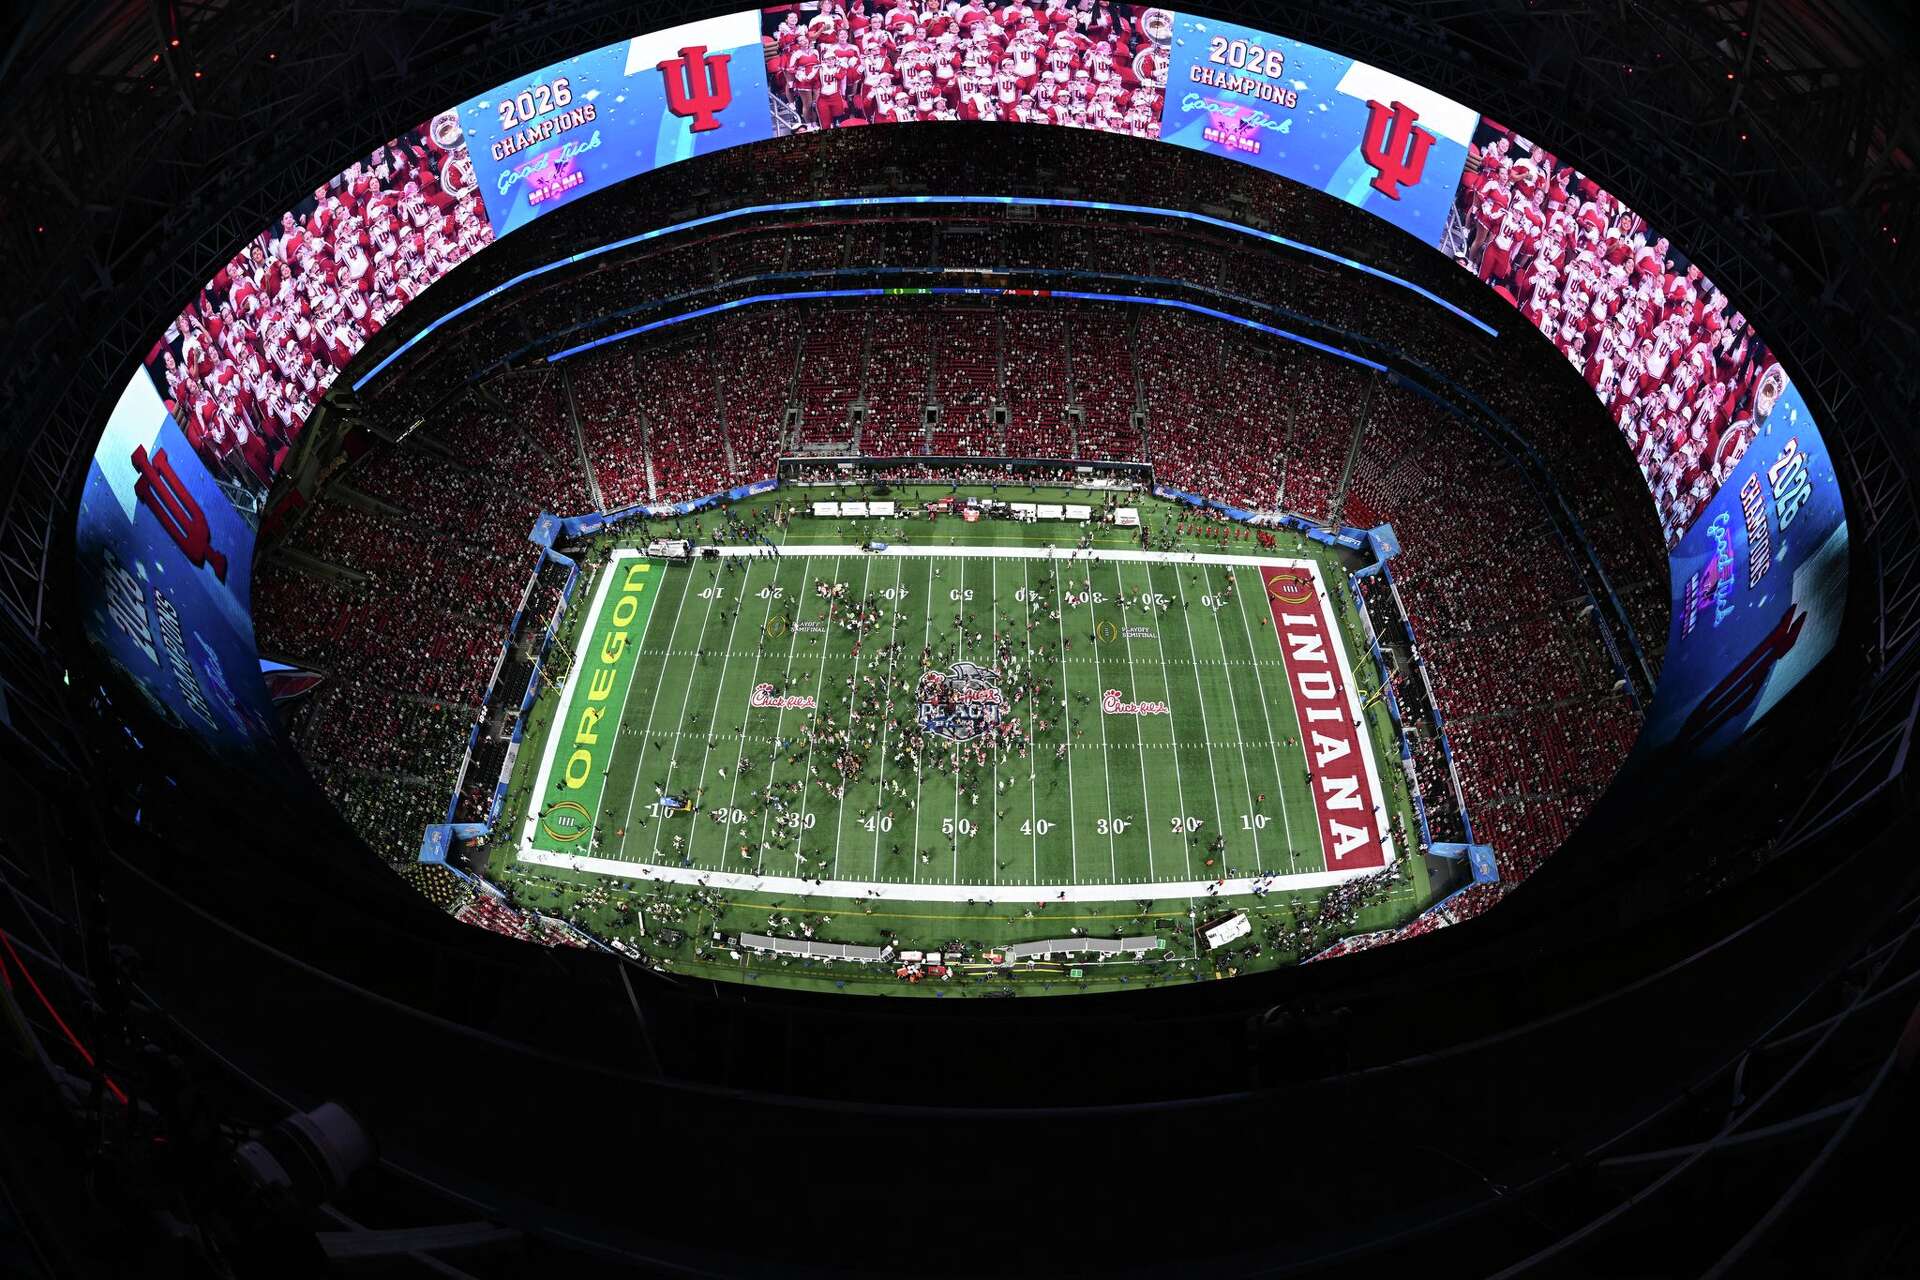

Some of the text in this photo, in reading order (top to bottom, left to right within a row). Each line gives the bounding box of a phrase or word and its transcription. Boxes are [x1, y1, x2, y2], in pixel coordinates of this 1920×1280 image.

[1209, 35, 1285, 79] 2026
[1190, 64, 1298, 109] CHAMPIONS
[499, 76, 573, 131] 2026
[1180, 92, 1293, 134] Good Luck
[491, 104, 597, 161] CHAMPIONS
[1203, 127, 1261, 154] MIAMI
[497, 130, 601, 195] Good Luck
[528, 171, 585, 206] MIAMI
[1767, 437, 1813, 532] 2026
[1338, 534, 1362, 546] ESPN
[1740, 472, 1770, 590] CHAMPIONS
[702, 587, 724, 599] 10
[885, 588, 909, 600] 40
[950, 589, 974, 601] 50
[1015, 590, 1038, 602] 40
[1201, 595, 1224, 607] 10
[565, 564, 650, 789] OREGON
[1103, 688, 1169, 715] Chick-fil-A
[1281, 613, 1370, 859] INDIANA
[718, 808, 742, 824] 20
[864, 817, 892, 832] 40
[942, 818, 970, 834] 50
[1020, 819, 1048, 835] 40
[1097, 818, 1124, 834] 30
[1241, 814, 1266, 830] 10
